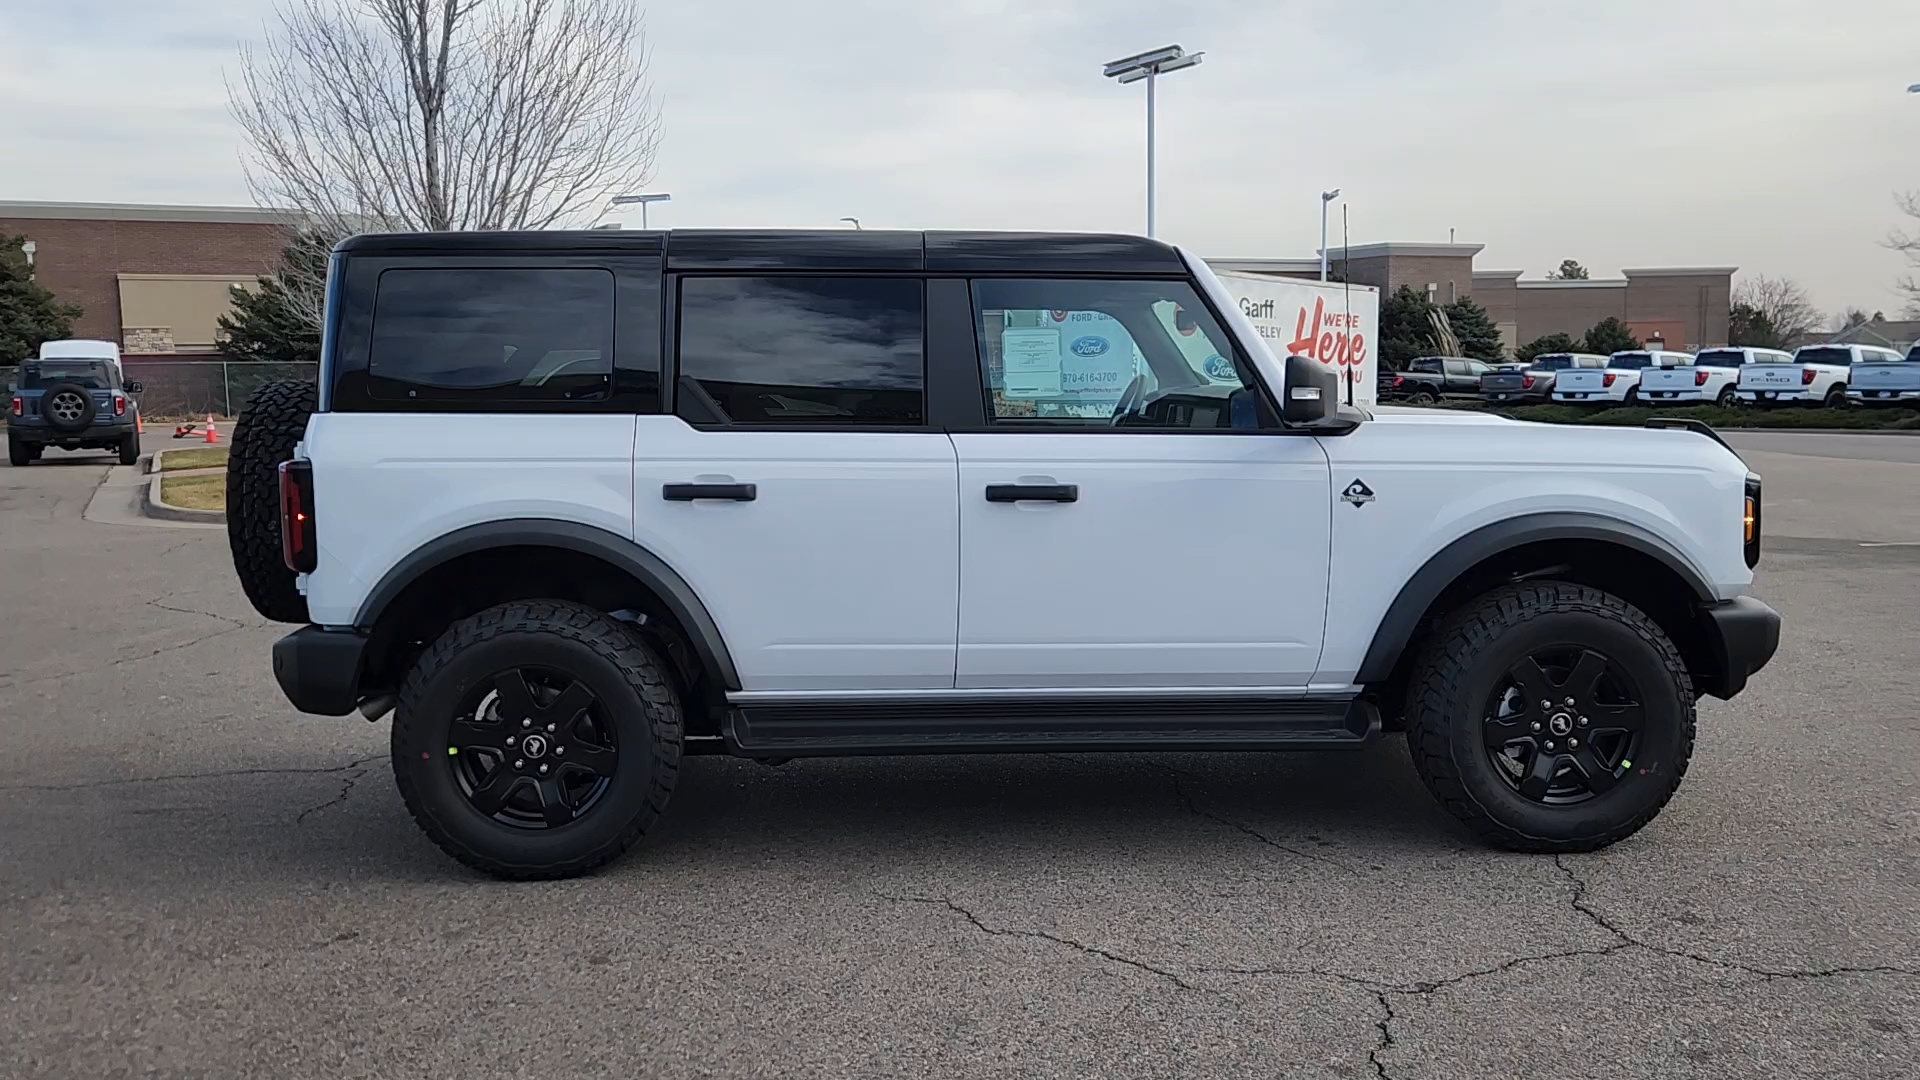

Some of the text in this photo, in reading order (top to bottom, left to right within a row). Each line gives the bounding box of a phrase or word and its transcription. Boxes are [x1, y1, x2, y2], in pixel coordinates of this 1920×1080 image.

[1239, 297, 1274, 319] Garff
[1071, 313, 1092, 323] FORD
[1324, 313, 1359, 328] WE'RE
[1287, 295, 1367, 366] Here
[1077, 339, 1102, 354] Ford
[1063, 371, 1118, 383] 970-616-3700
